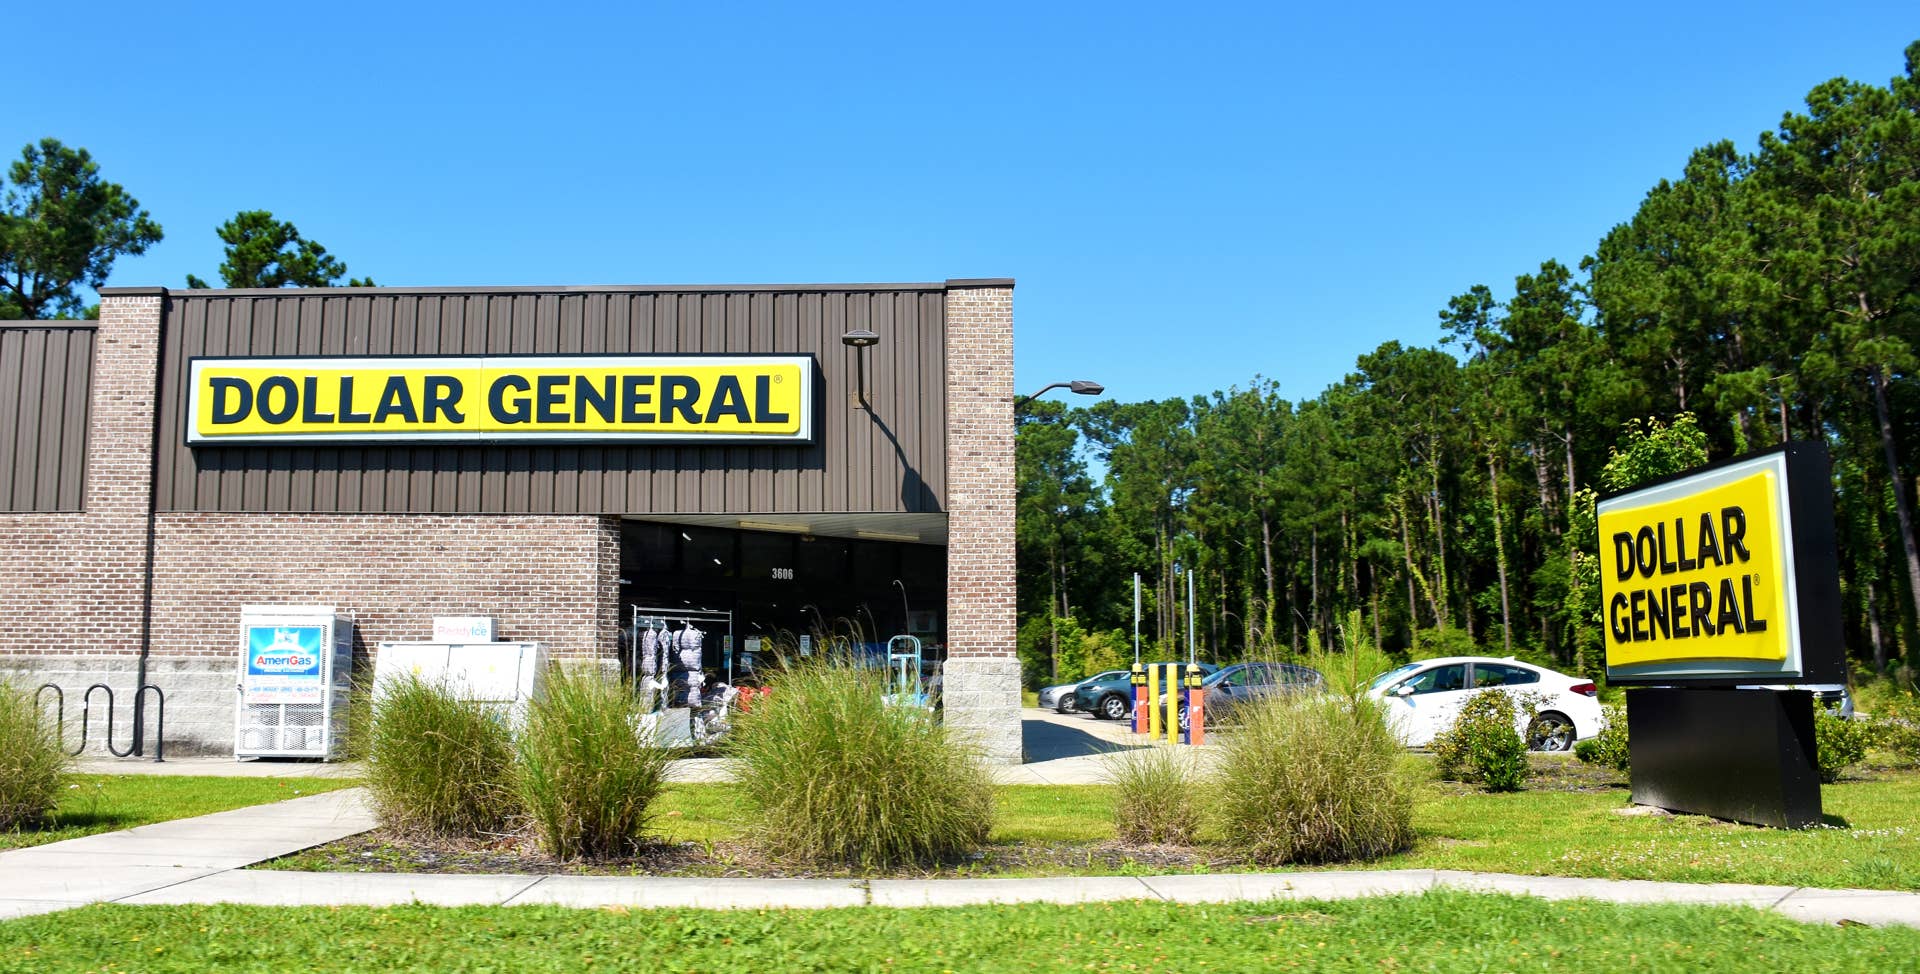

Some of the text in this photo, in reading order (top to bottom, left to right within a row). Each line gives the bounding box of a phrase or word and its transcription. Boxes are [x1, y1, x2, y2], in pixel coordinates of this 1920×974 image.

[209, 374, 790, 425] DOLLAR GENERAL
[1612, 505, 1751, 583] DOLLAR
[771, 567, 794, 580] 3606
[1610, 573, 1768, 645] GENERAL
[256, 655, 312, 666] AmeriGas
